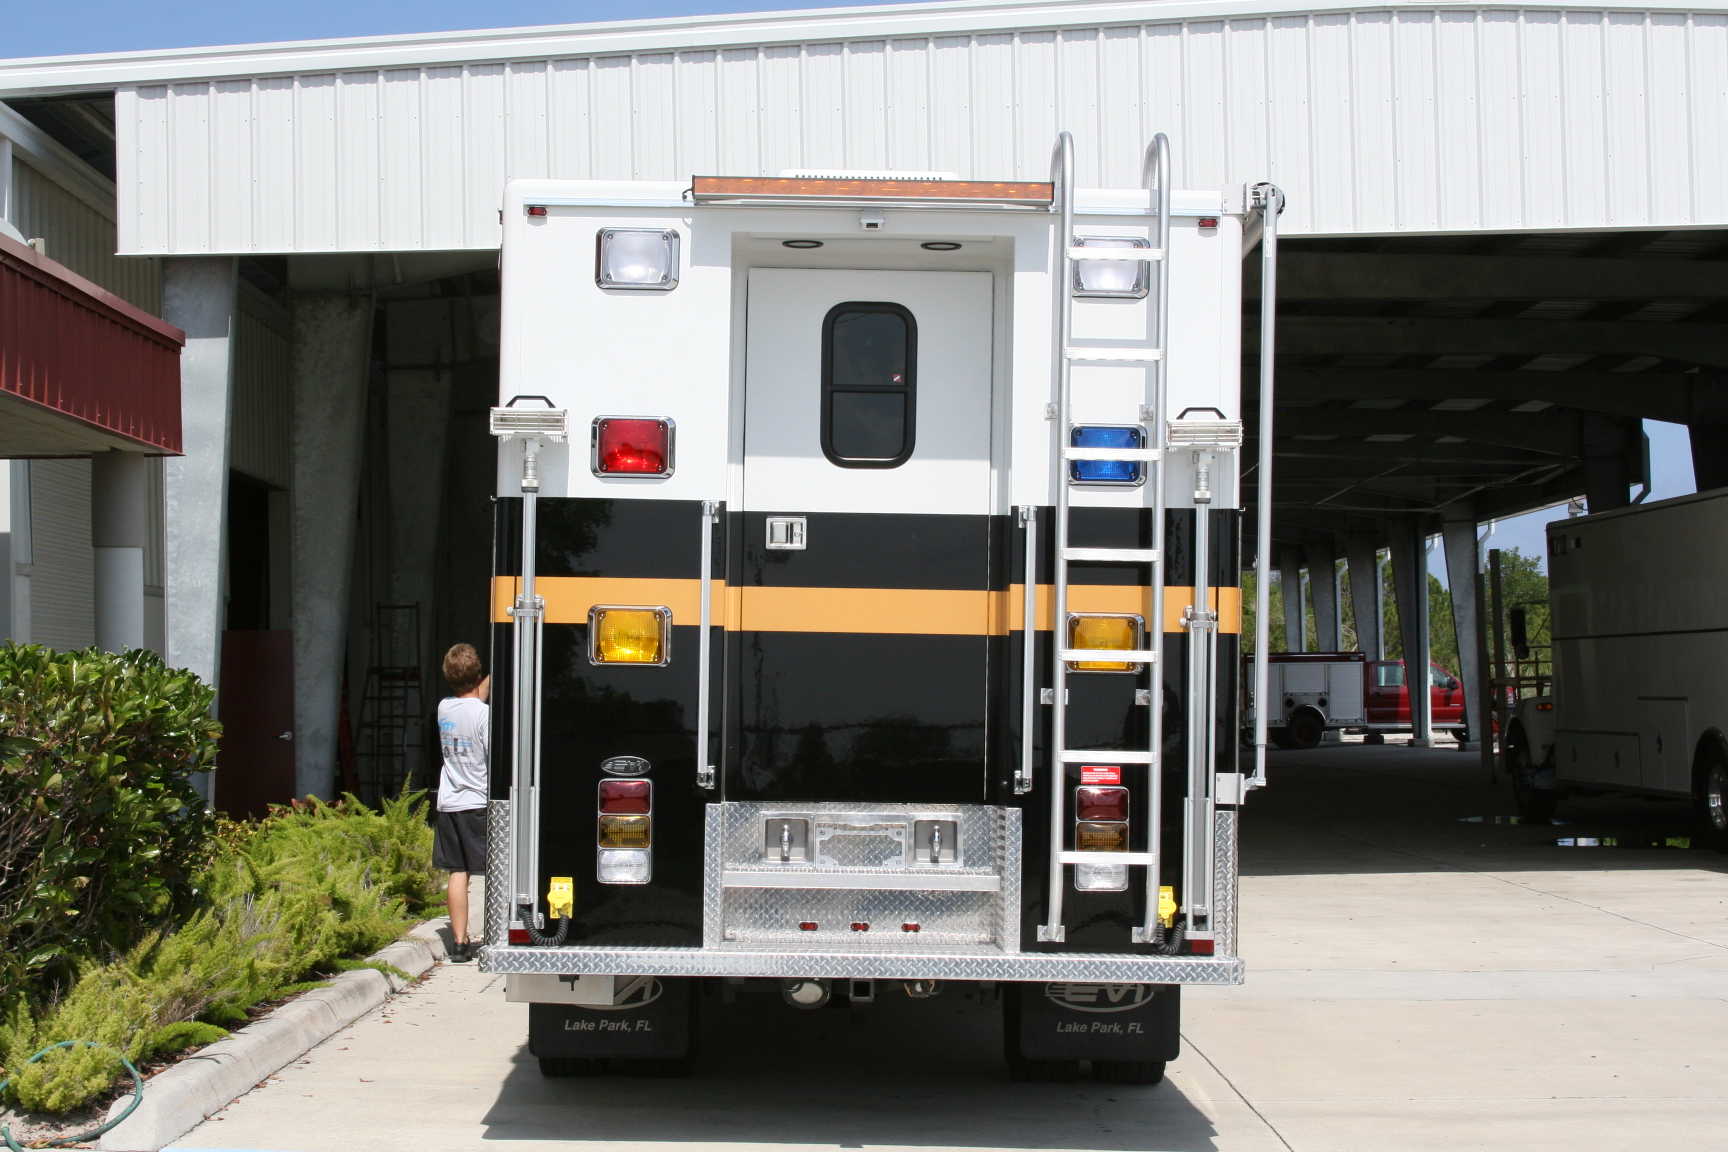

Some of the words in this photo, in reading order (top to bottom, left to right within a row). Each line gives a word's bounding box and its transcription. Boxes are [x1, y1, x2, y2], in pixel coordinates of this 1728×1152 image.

[563, 1018, 596, 1031] Lake
[598, 1018, 631, 1034] Park,
[635, 1019, 652, 1032] FL
[1056, 1020, 1088, 1033] Lake
[1090, 1021, 1124, 1036] Park,
[1127, 1022, 1144, 1034] FL
